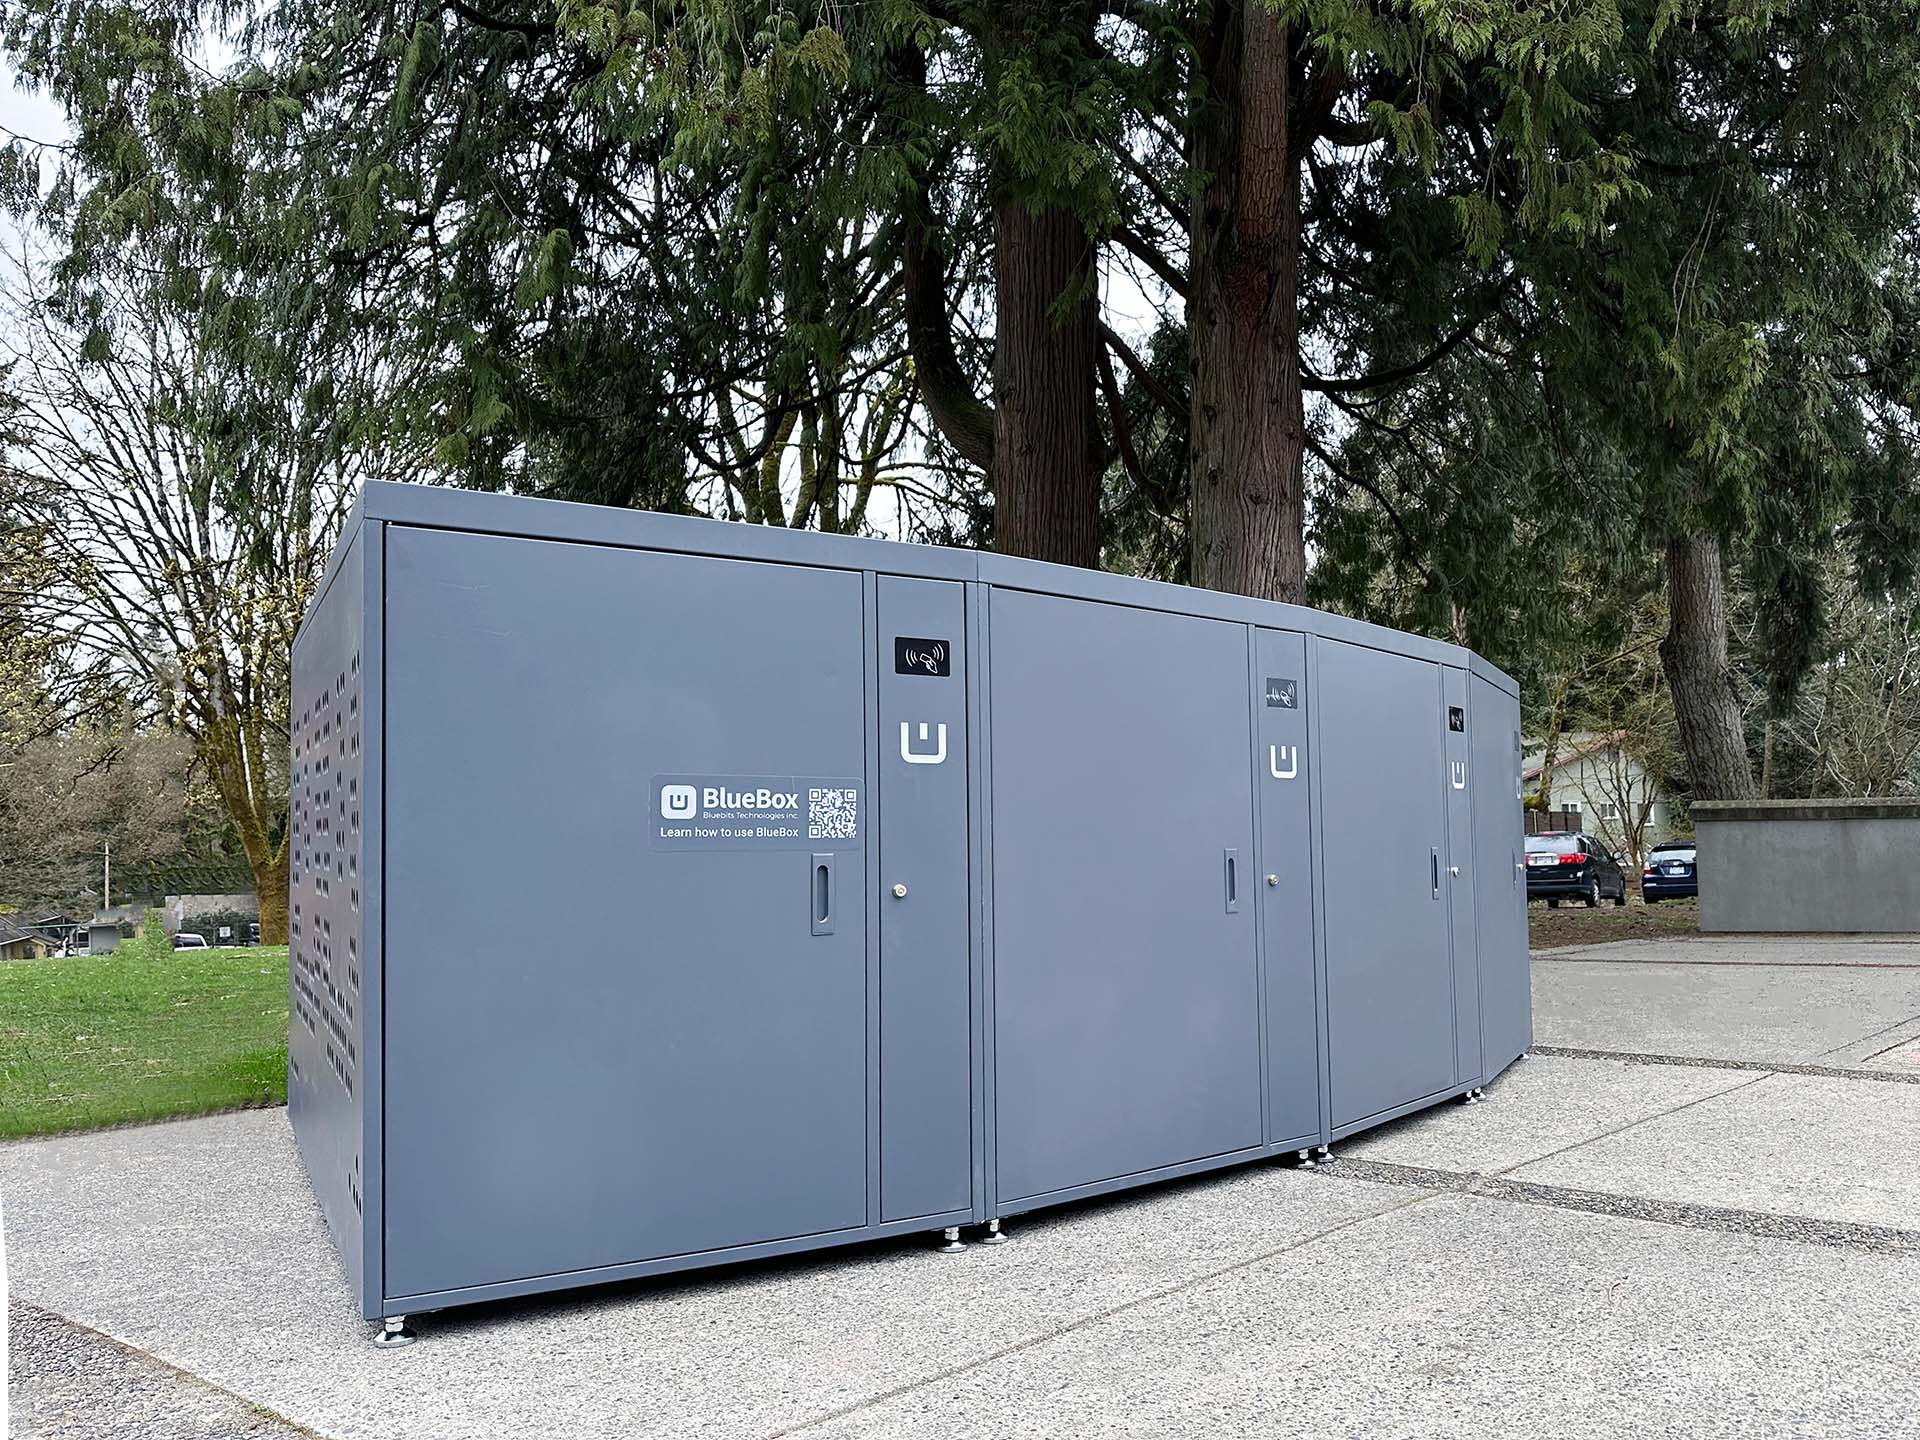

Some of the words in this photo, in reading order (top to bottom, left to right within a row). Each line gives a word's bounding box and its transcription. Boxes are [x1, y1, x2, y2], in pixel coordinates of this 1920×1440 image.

[703, 787, 799, 809] BlueBox
[703, 811, 735, 819] Bluebits
[736, 811, 785, 820] Technologies
[660, 827, 692, 837] Learn
[694, 827, 718, 837] how
[720, 827, 731, 837] to
[734, 828, 753, 837] use
[756, 827, 799, 837] BlueBox
